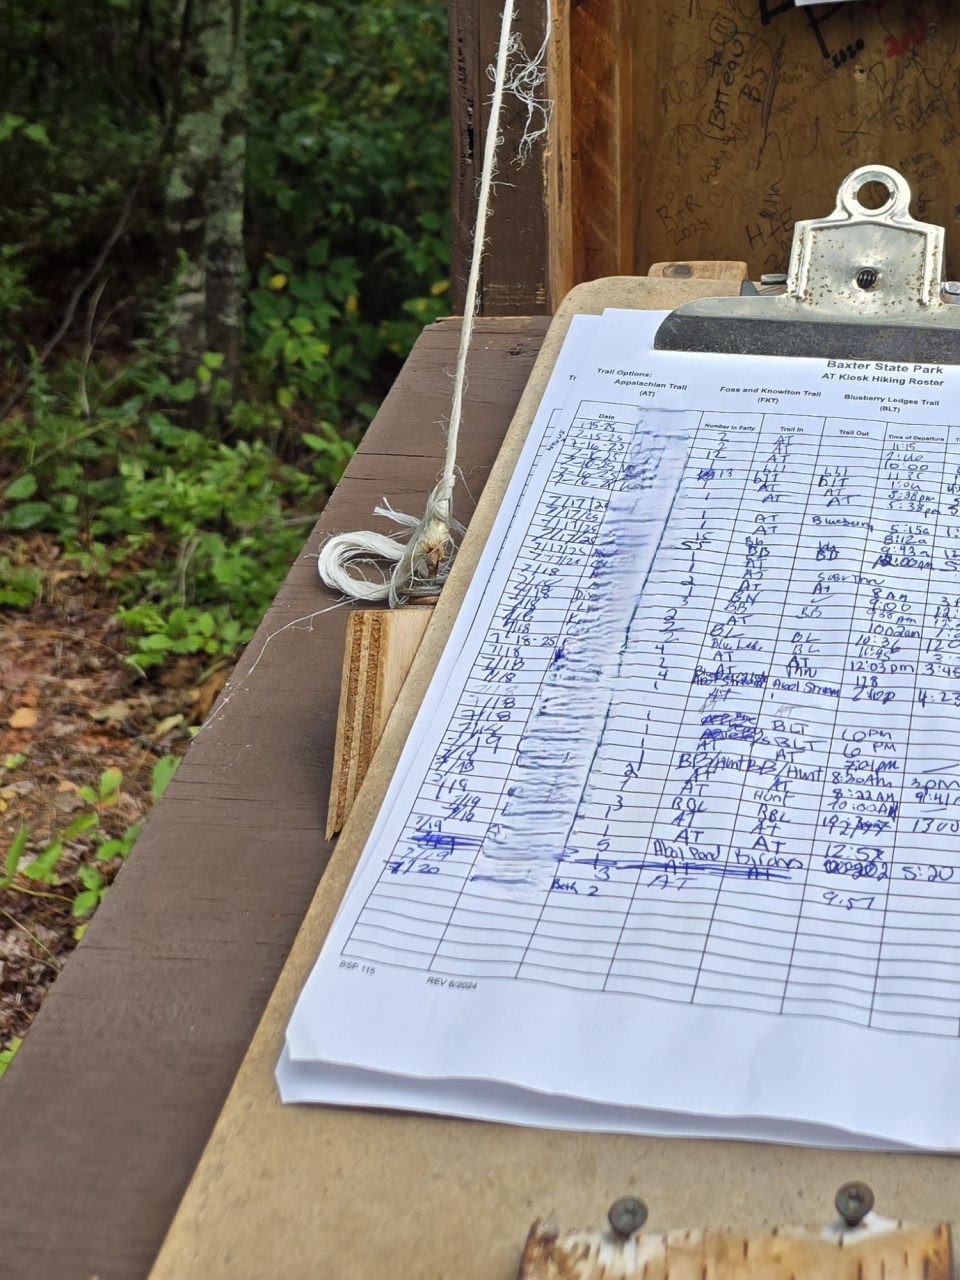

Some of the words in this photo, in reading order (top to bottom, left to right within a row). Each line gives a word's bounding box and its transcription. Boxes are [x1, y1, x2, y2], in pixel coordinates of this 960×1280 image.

[826, 360, 871, 371] Baxter
[874, 362, 909, 373] State
[913, 364, 944, 374] Park
[616, 369, 653, 378] Options:
[821, 372, 836, 380] AT
[838, 373, 869, 382] Kiosk
[872, 376, 906, 386] Hiking
[908, 378, 945, 386] Roster
[614, 379, 666, 389] Appalachian
[669, 382, 688, 391] Trail
[639, 390, 656, 398] (AT)
[719, 386, 741, 394] Foss
[760, 388, 801, 396] Knowlton
[804, 390, 822, 398] Trail
[757, 397, 779, 405] (FKT)
[844, 394, 885, 403] Blueberry
[879, 405, 901, 413] (BLT)
[704, 422, 730, 430] Number
[902, 865, 954, 884] 5:20
[338, 959, 359, 970] BSP
[426, 975, 447, 987] REV
[448, 979, 478, 991] 6/2024
